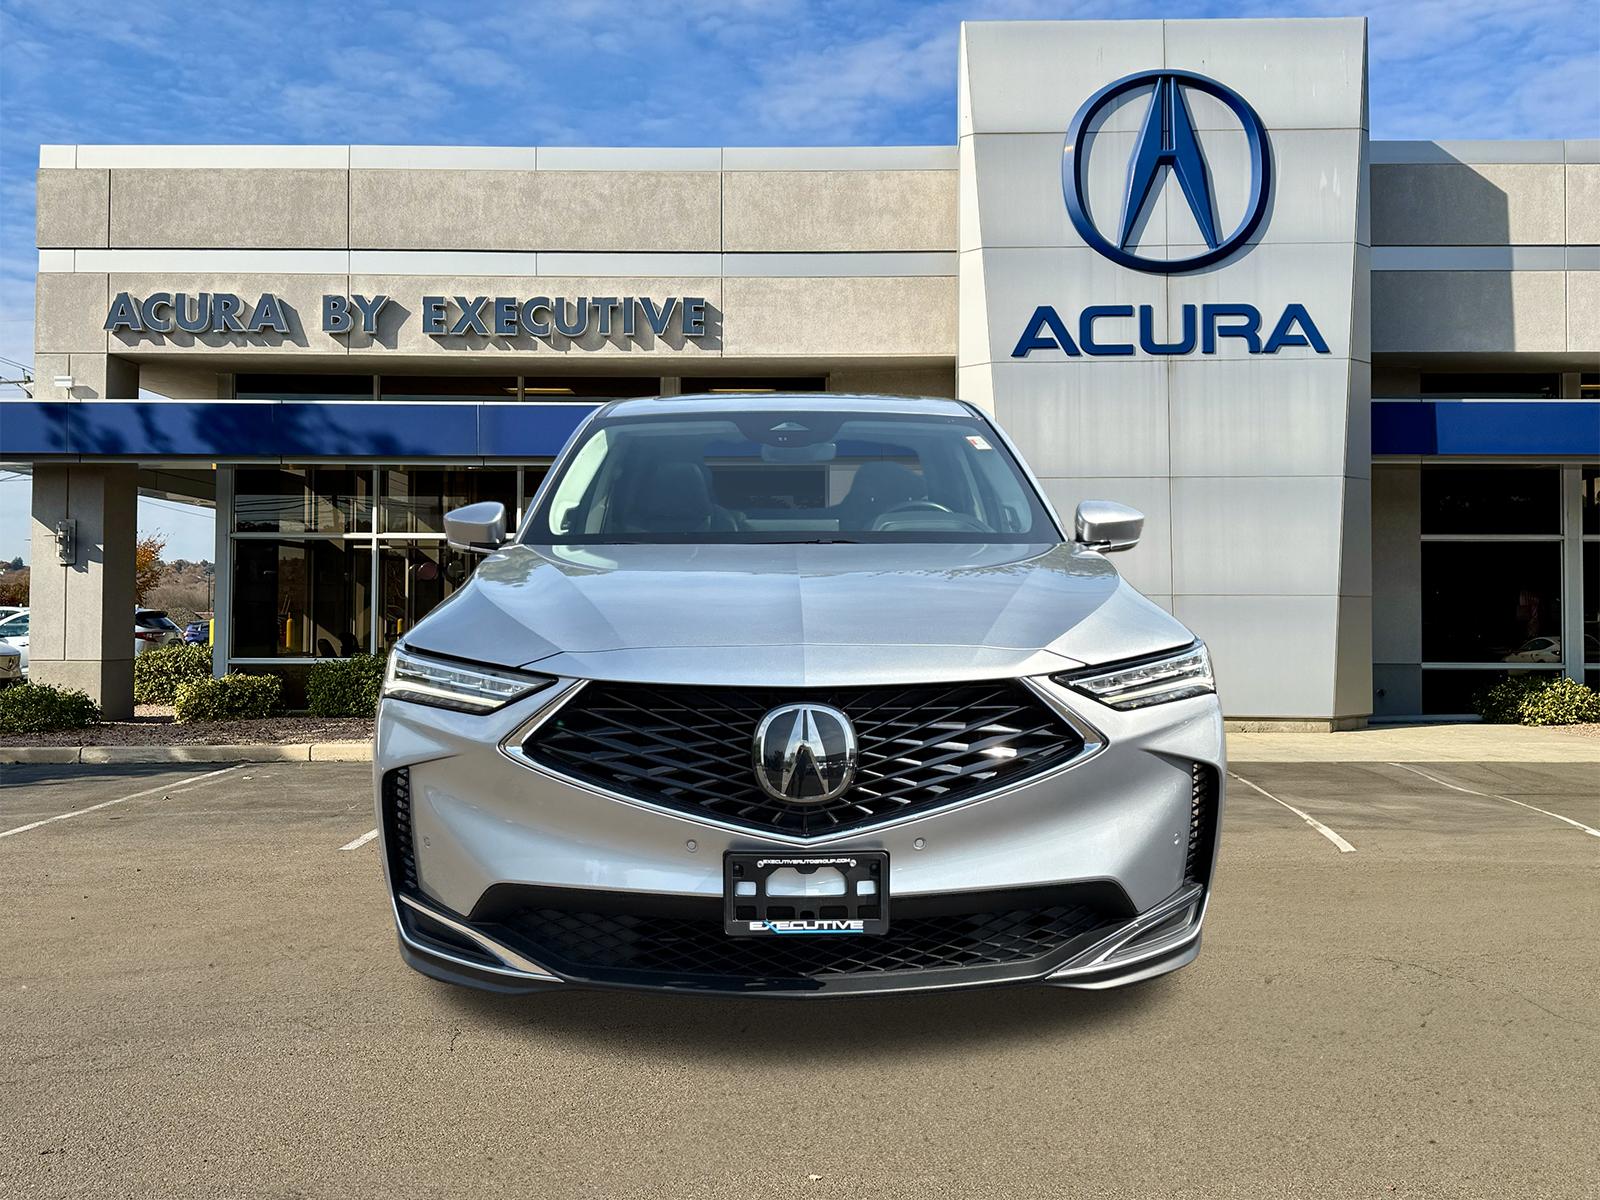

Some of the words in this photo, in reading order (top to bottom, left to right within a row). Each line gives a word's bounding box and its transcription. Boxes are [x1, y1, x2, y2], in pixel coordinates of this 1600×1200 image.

[103, 291, 290, 333] ACURA
[322, 294, 391, 333] BY
[422, 296, 705, 337] EXECUTIVE
[1011, 303, 1333, 357] ACURA
[749, 919, 864, 934] EXECUTIVE
